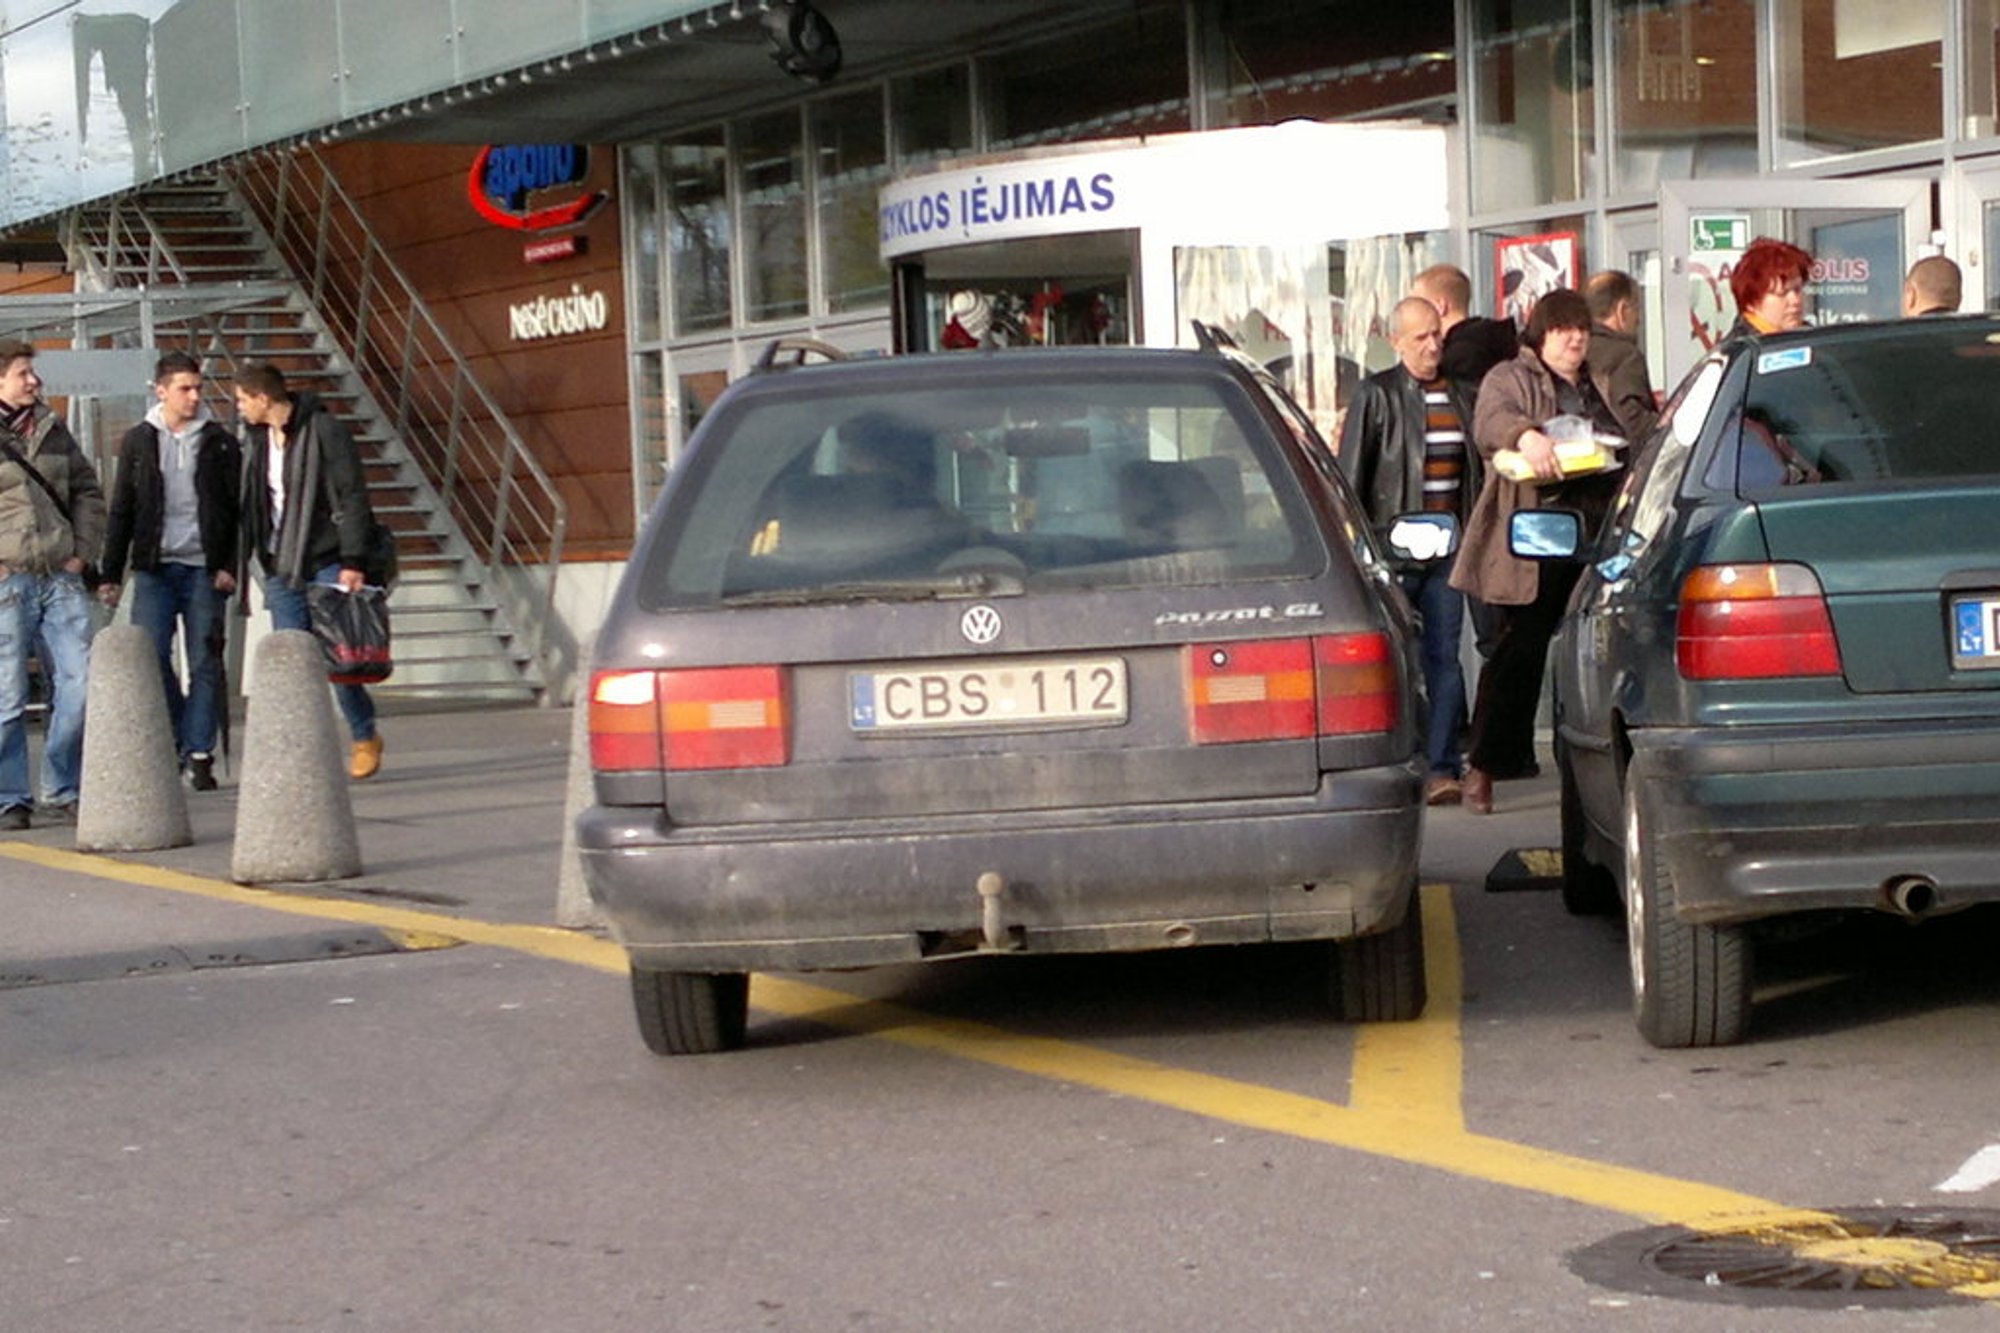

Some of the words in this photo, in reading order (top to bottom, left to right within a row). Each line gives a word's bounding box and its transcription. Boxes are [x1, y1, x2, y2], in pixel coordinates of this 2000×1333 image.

[961, 173, 1115, 237] ĮĖJIMAS
[1284, 603, 1325, 617] GL
[884, 673, 989, 719] CBS
[1031, 667, 1117, 713] 112
